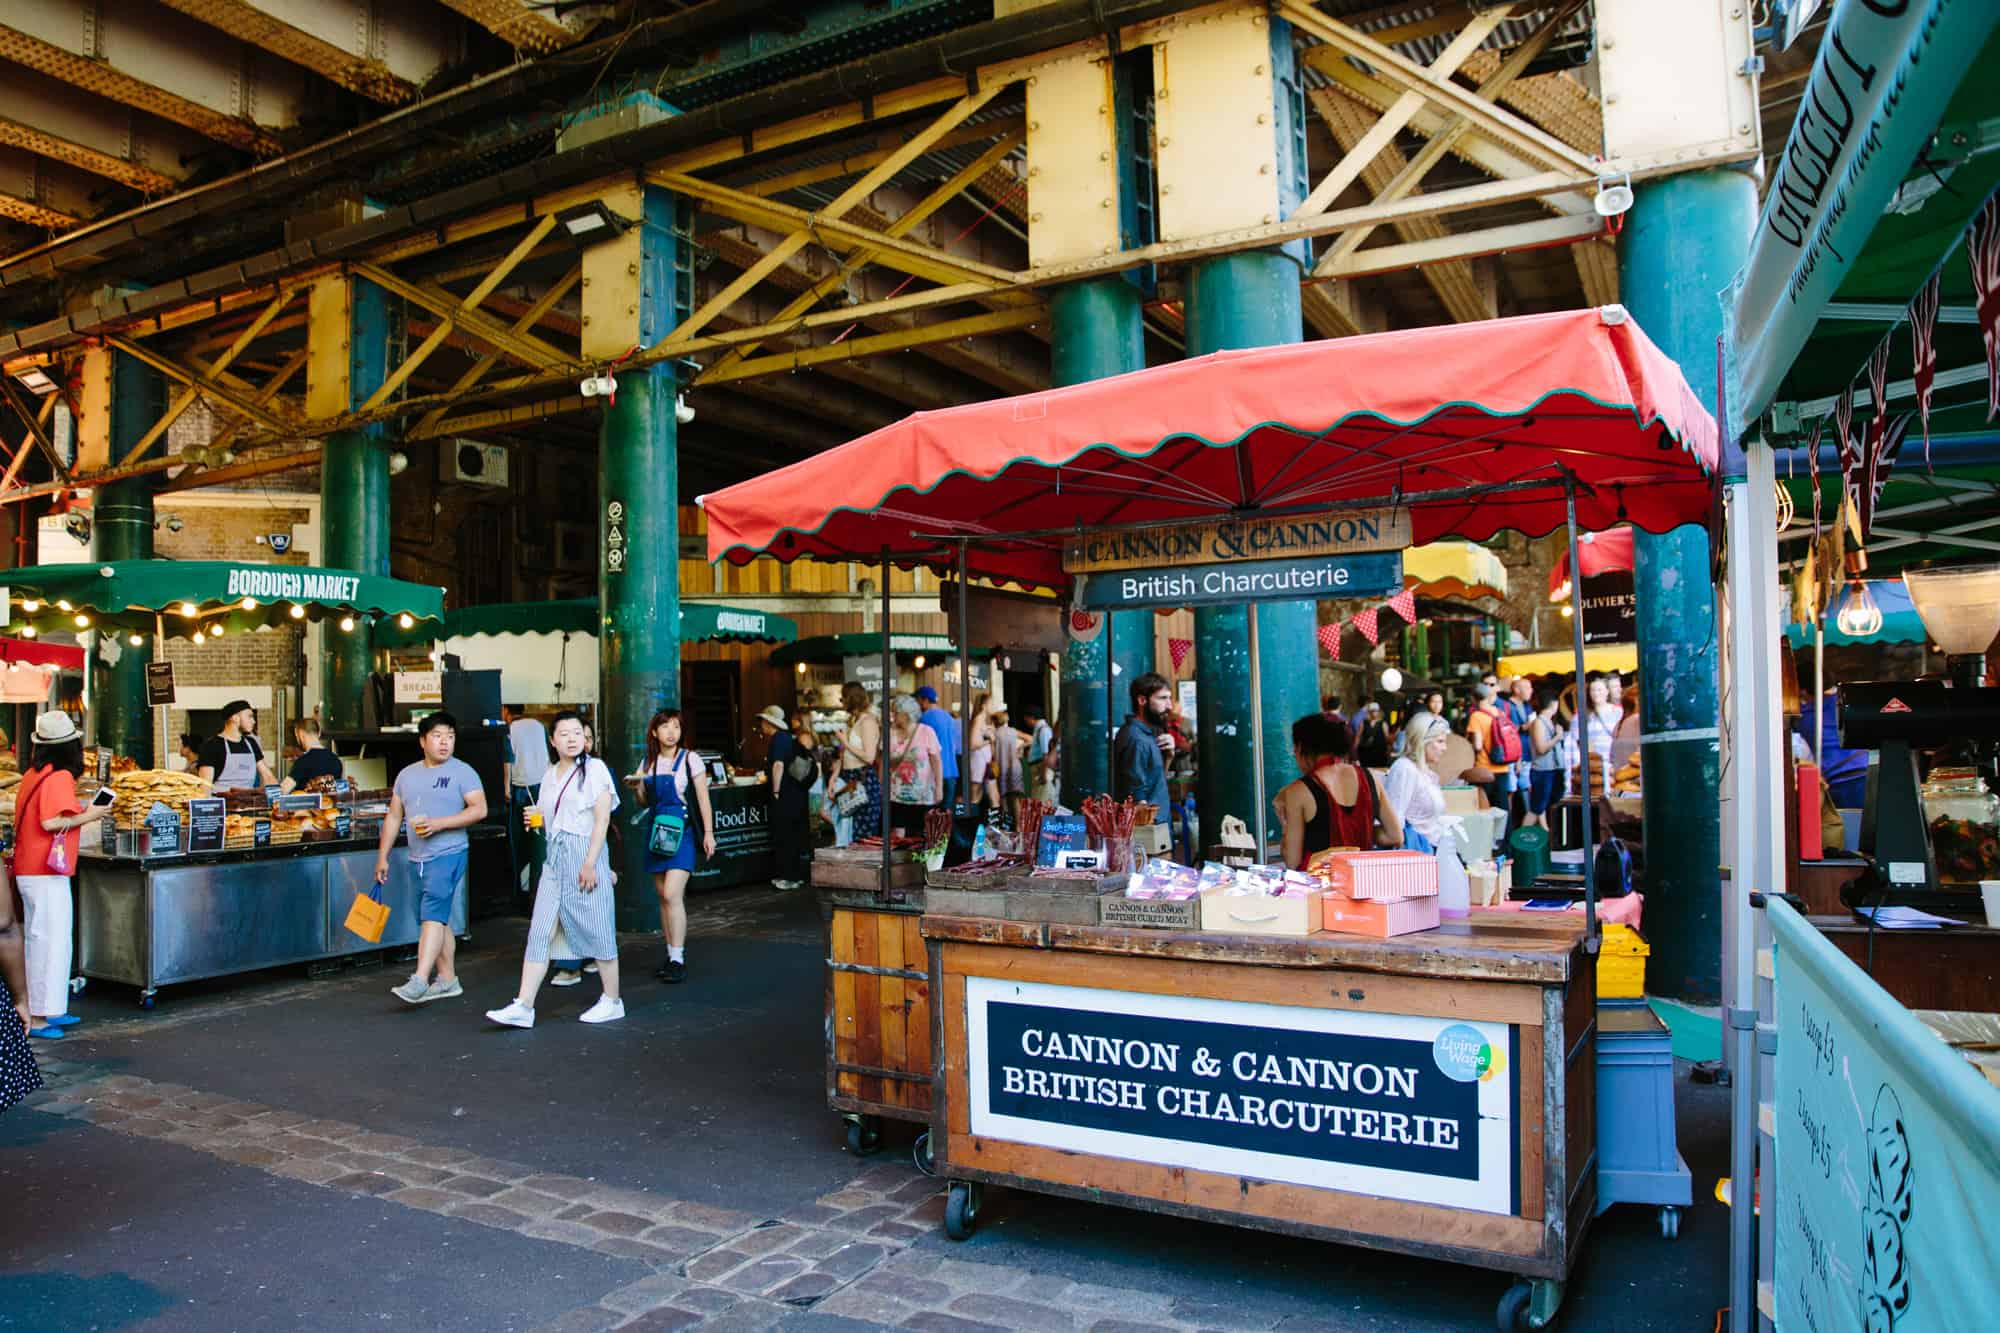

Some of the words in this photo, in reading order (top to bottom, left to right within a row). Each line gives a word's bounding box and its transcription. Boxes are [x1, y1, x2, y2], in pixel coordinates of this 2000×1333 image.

[1088, 531, 1205, 561] CANNON
[1212, 523, 1248, 558] &
[1249, 517, 1381, 550] CANNON
[228, 569, 301, 597] BOROUGH
[303, 574, 360, 600] MARKET
[1122, 575, 1196, 599] British
[1203, 564, 1349, 593] Charcuterie
[433, 776, 451, 790] JW
[714, 808, 746, 828] Food
[749, 806, 760, 824] &
[1105, 912, 1136, 921] BRITISH
[1109, 904, 1142, 912] CANNON
[1150, 904, 1184, 913] CANNON
[1440, 1036, 1481, 1055] Living
[1022, 1029, 1180, 1072] CANNON
[1192, 1047, 1221, 1077] &
[1232, 1051, 1419, 1098] CANNON
[1449, 1050, 1486, 1066] Wage
[1002, 1066, 1147, 1110] BRITISH
[1157, 1086, 1459, 1150] CHARCUTERIE
